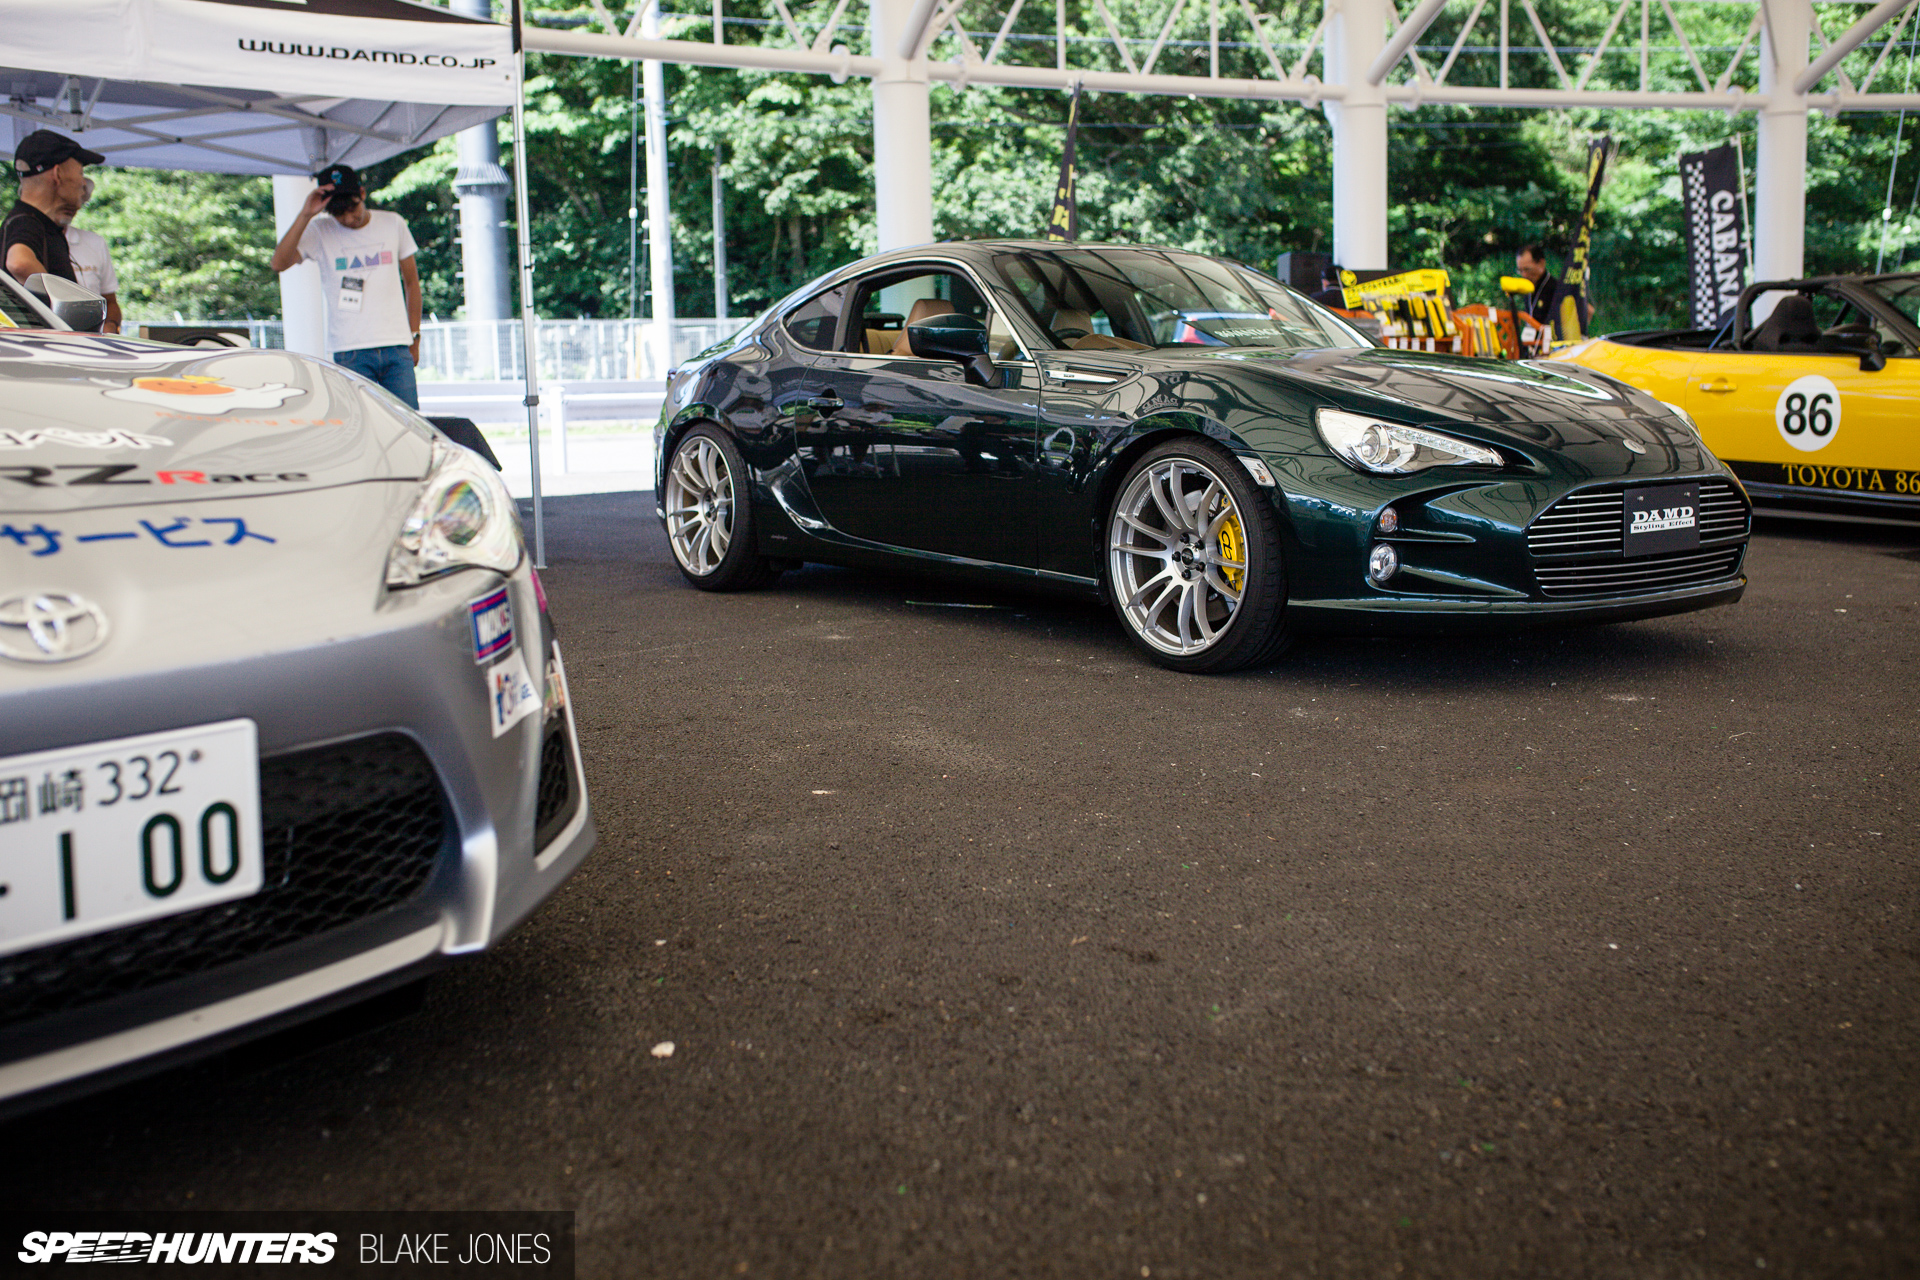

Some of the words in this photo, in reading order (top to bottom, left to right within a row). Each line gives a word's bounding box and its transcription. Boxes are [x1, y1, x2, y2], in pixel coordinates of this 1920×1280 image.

[1710, 189, 1741, 317] CABANA
[1783, 392, 1833, 437] 86
[156, 470, 311, 485] Race
[1782, 463, 1887, 492] TOYOTA
[1895, 470, 1920, 495] 86
[1632, 506, 1694, 524] DAMD
[1633, 523, 1665, 532] Styling
[1669, 519, 1693, 527] Effect
[0, 517, 277, 557] サービス
[97, 750, 183, 806] 332
